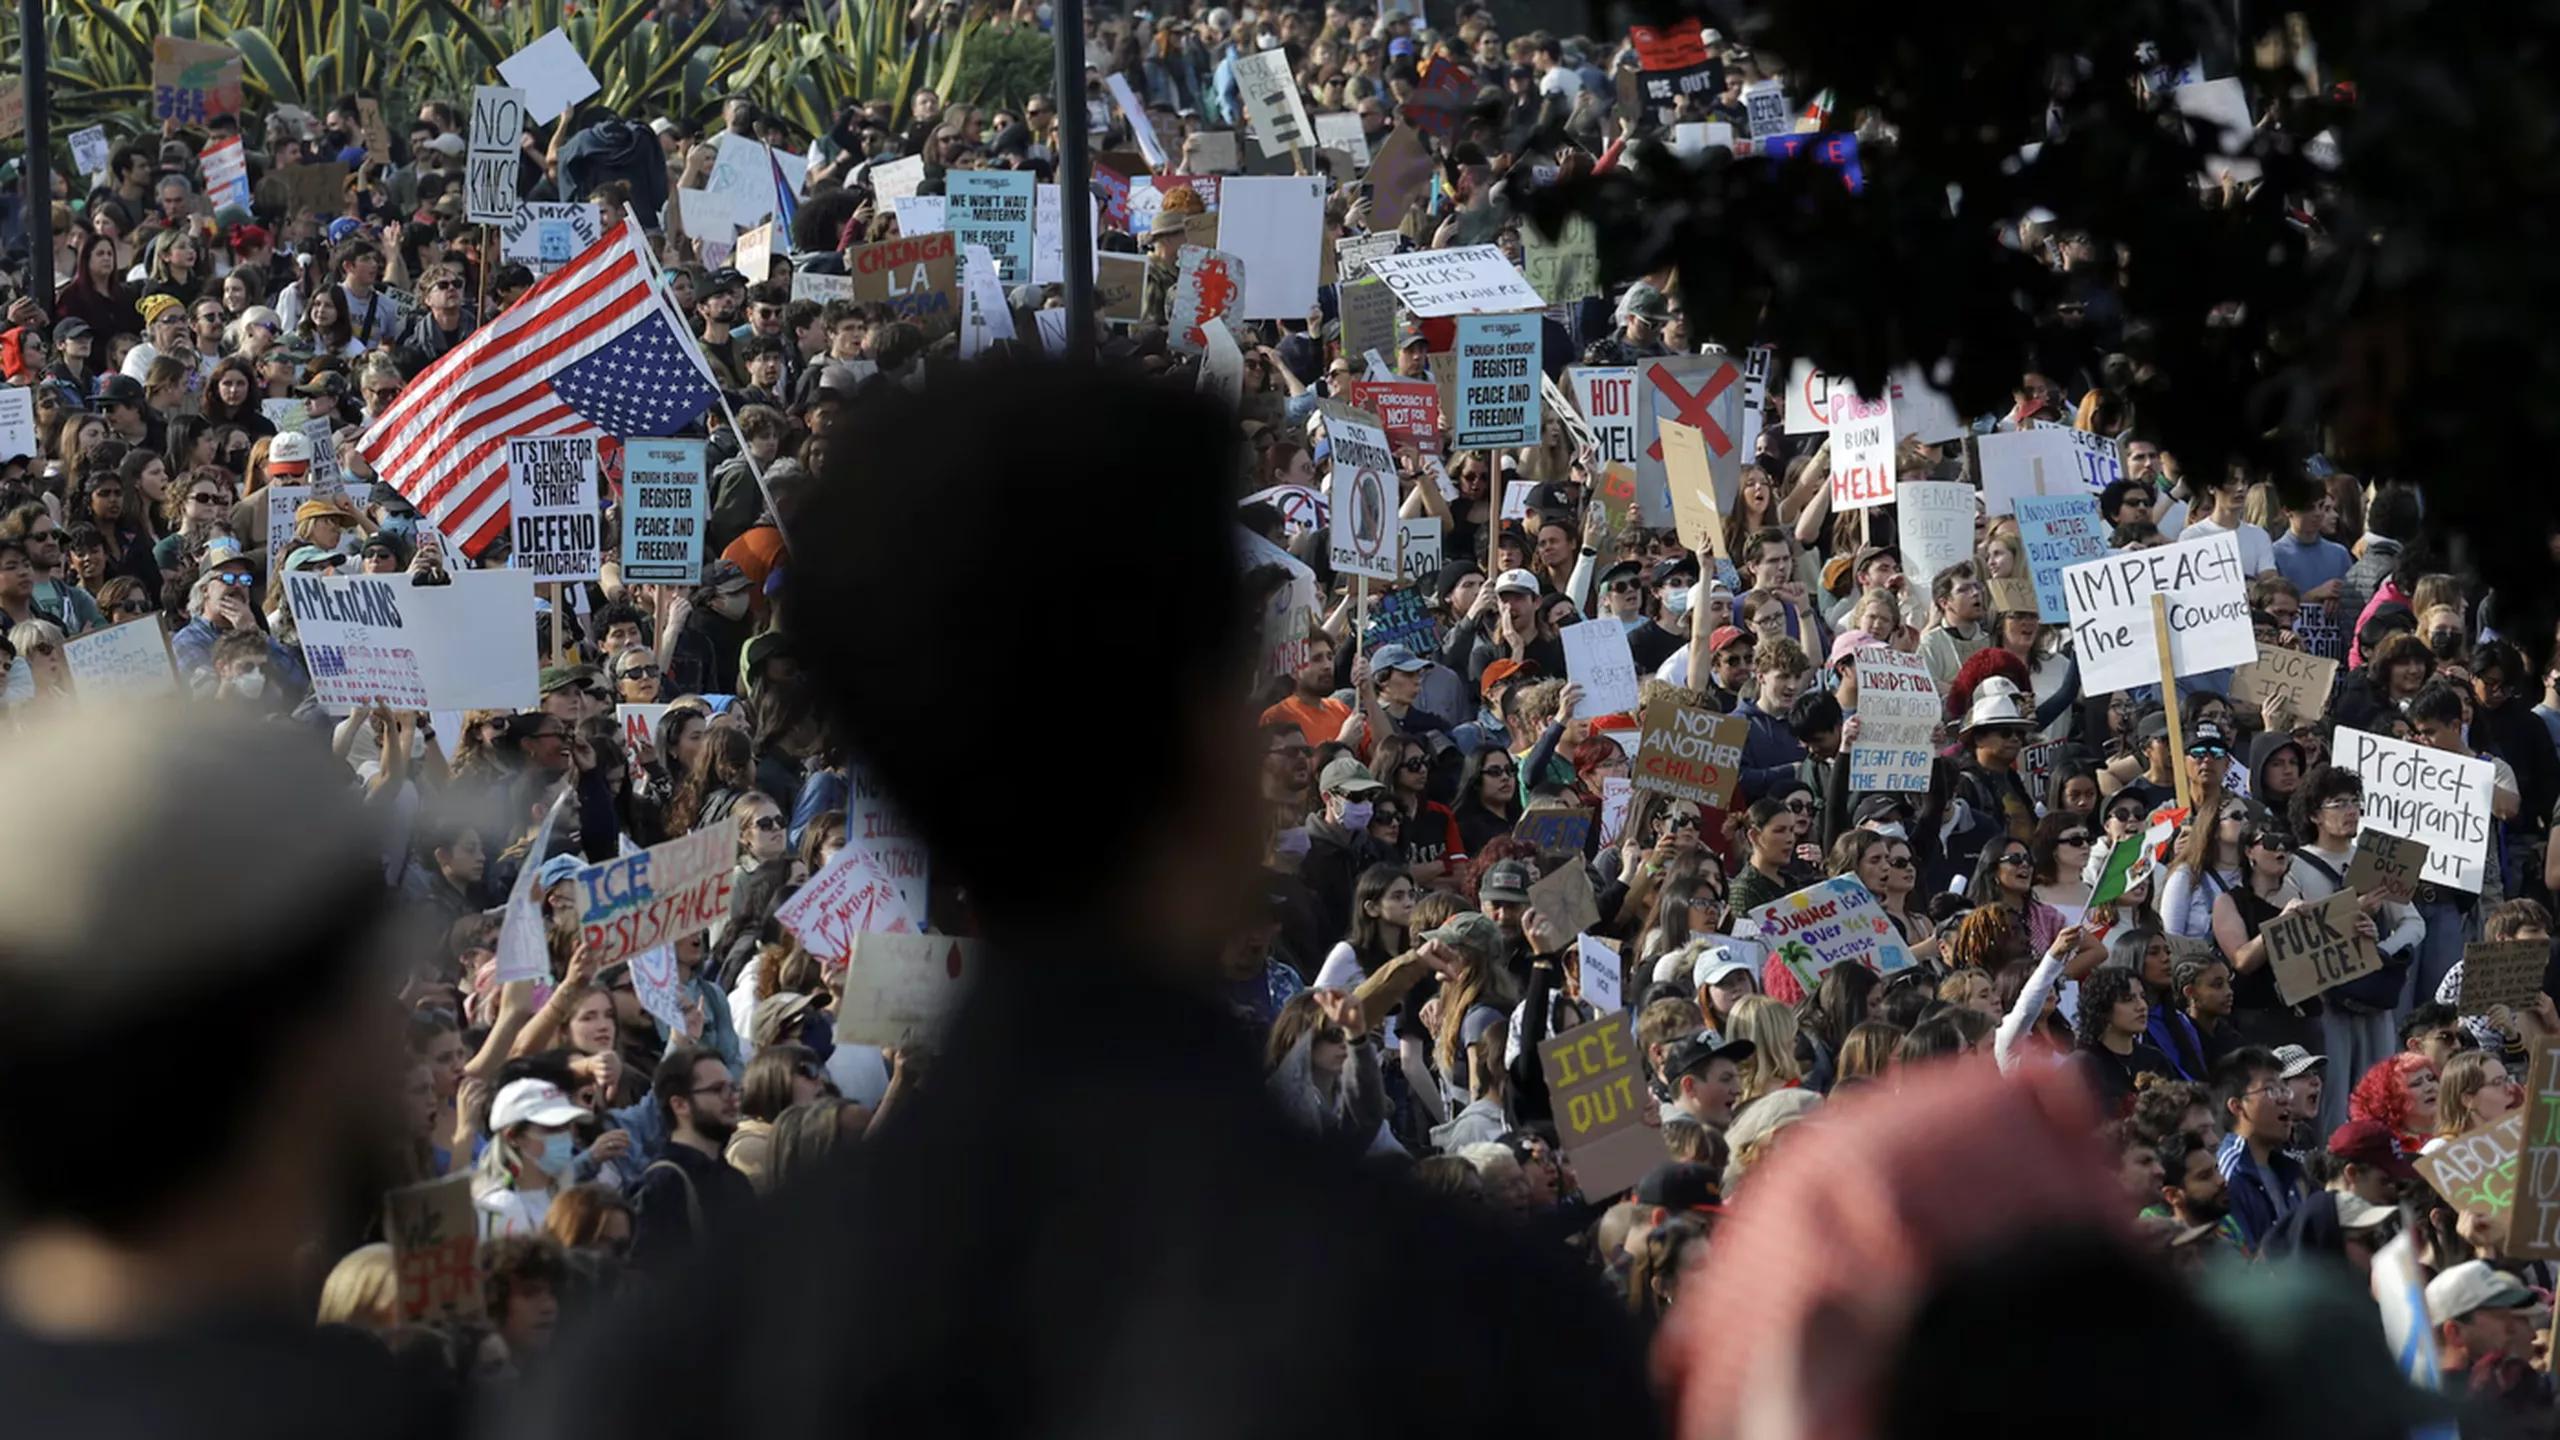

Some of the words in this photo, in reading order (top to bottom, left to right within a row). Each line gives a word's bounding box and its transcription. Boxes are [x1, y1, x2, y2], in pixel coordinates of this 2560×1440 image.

[1680, 71, 1711, 94] OUT
[474, 97, 519, 147] NO
[471, 158, 518, 213] KINGS
[951, 195, 966, 208] WE
[969, 195, 1001, 208] WON'T
[1003, 195, 1028, 208] WAIT
[502, 203, 536, 244] NOT
[539, 206, 564, 219] MY
[972, 208, 1027, 222] MIDTERMS
[961, 229, 979, 244] THE
[980, 229, 1015, 244] PEOPLE
[857, 233, 956, 275] CHINGA
[1369, 248, 1501, 273] INCOMPETENT
[887, 262, 931, 298] LA
[1386, 266, 1477, 291] CUCKS
[1464, 345, 1495, 357] ENOUGH
[1496, 343, 1505, 356] IS
[1472, 357, 1528, 379] REGISTER
[1377, 393, 1425, 407] DEMOCRACY
[1467, 385, 1505, 405] PEACE
[1508, 384, 1531, 403] AND
[1590, 379, 1632, 417] HOT
[1387, 407, 1409, 425] NOT
[1469, 406, 1525, 428] FREEDOM
[1844, 425, 1880, 450] BURN
[511, 440, 538, 464] IT'S
[539, 438, 569, 462] TIME
[570, 438, 593, 462] FOR
[1855, 452, 1867, 462] IN
[522, 463, 531, 486] A
[533, 460, 586, 485] GENERAL
[631, 471, 660, 485] ENOUGH
[661, 471, 670, 485] IS
[1832, 462, 1894, 503] HELL
[531, 483, 580, 507] STRIKE!
[639, 488, 692, 509] REGISTER
[1908, 487, 1973, 511] SENATE
[517, 513, 596, 554] DEFEND
[634, 517, 671, 537] PEACE
[672, 516, 695, 537] AND
[1907, 517, 1954, 539] SHUT
[2044, 517, 2090, 537] NATIVES
[635, 541, 688, 561] FREEDOM
[1924, 543, 1955, 561] ICE
[2070, 540, 2240, 613] IMPEACH
[2074, 618, 2134, 661] The
[2168, 592, 2251, 633] Coward
[2300, 604, 2325, 627] THE
[2256, 651, 2317, 681] FUCK
[1861, 671, 1909, 692] INSIDE
[1907, 673, 1933, 692] YOU
[1675, 708, 1725, 739] NOT
[1643, 728, 1742, 770] ANOTHER
[1852, 749, 1898, 768] FIGHT
[1900, 750, 1928, 768] FOR
[1646, 756, 1719, 787] CHILD
[1850, 773, 1878, 790] THE
[1885, 773, 1931, 790] FUTURE
[2357, 735, 2473, 805] Protect
[2361, 828, 2401, 860] ICE
[2374, 857, 2409, 876] OUT
[2430, 852, 2472, 880] UT
[578, 850, 653, 924] ICE
[583, 868, 734, 965] RESISTANCE
[836, 882, 877, 926] NATION
[2269, 901, 2344, 961] FUCK
[1816, 937, 1876, 963] because
[2309, 937, 2366, 986] ICE!
[1551, 1021, 1629, 1089] ICE
[1567, 1075, 1635, 1134] OUT
